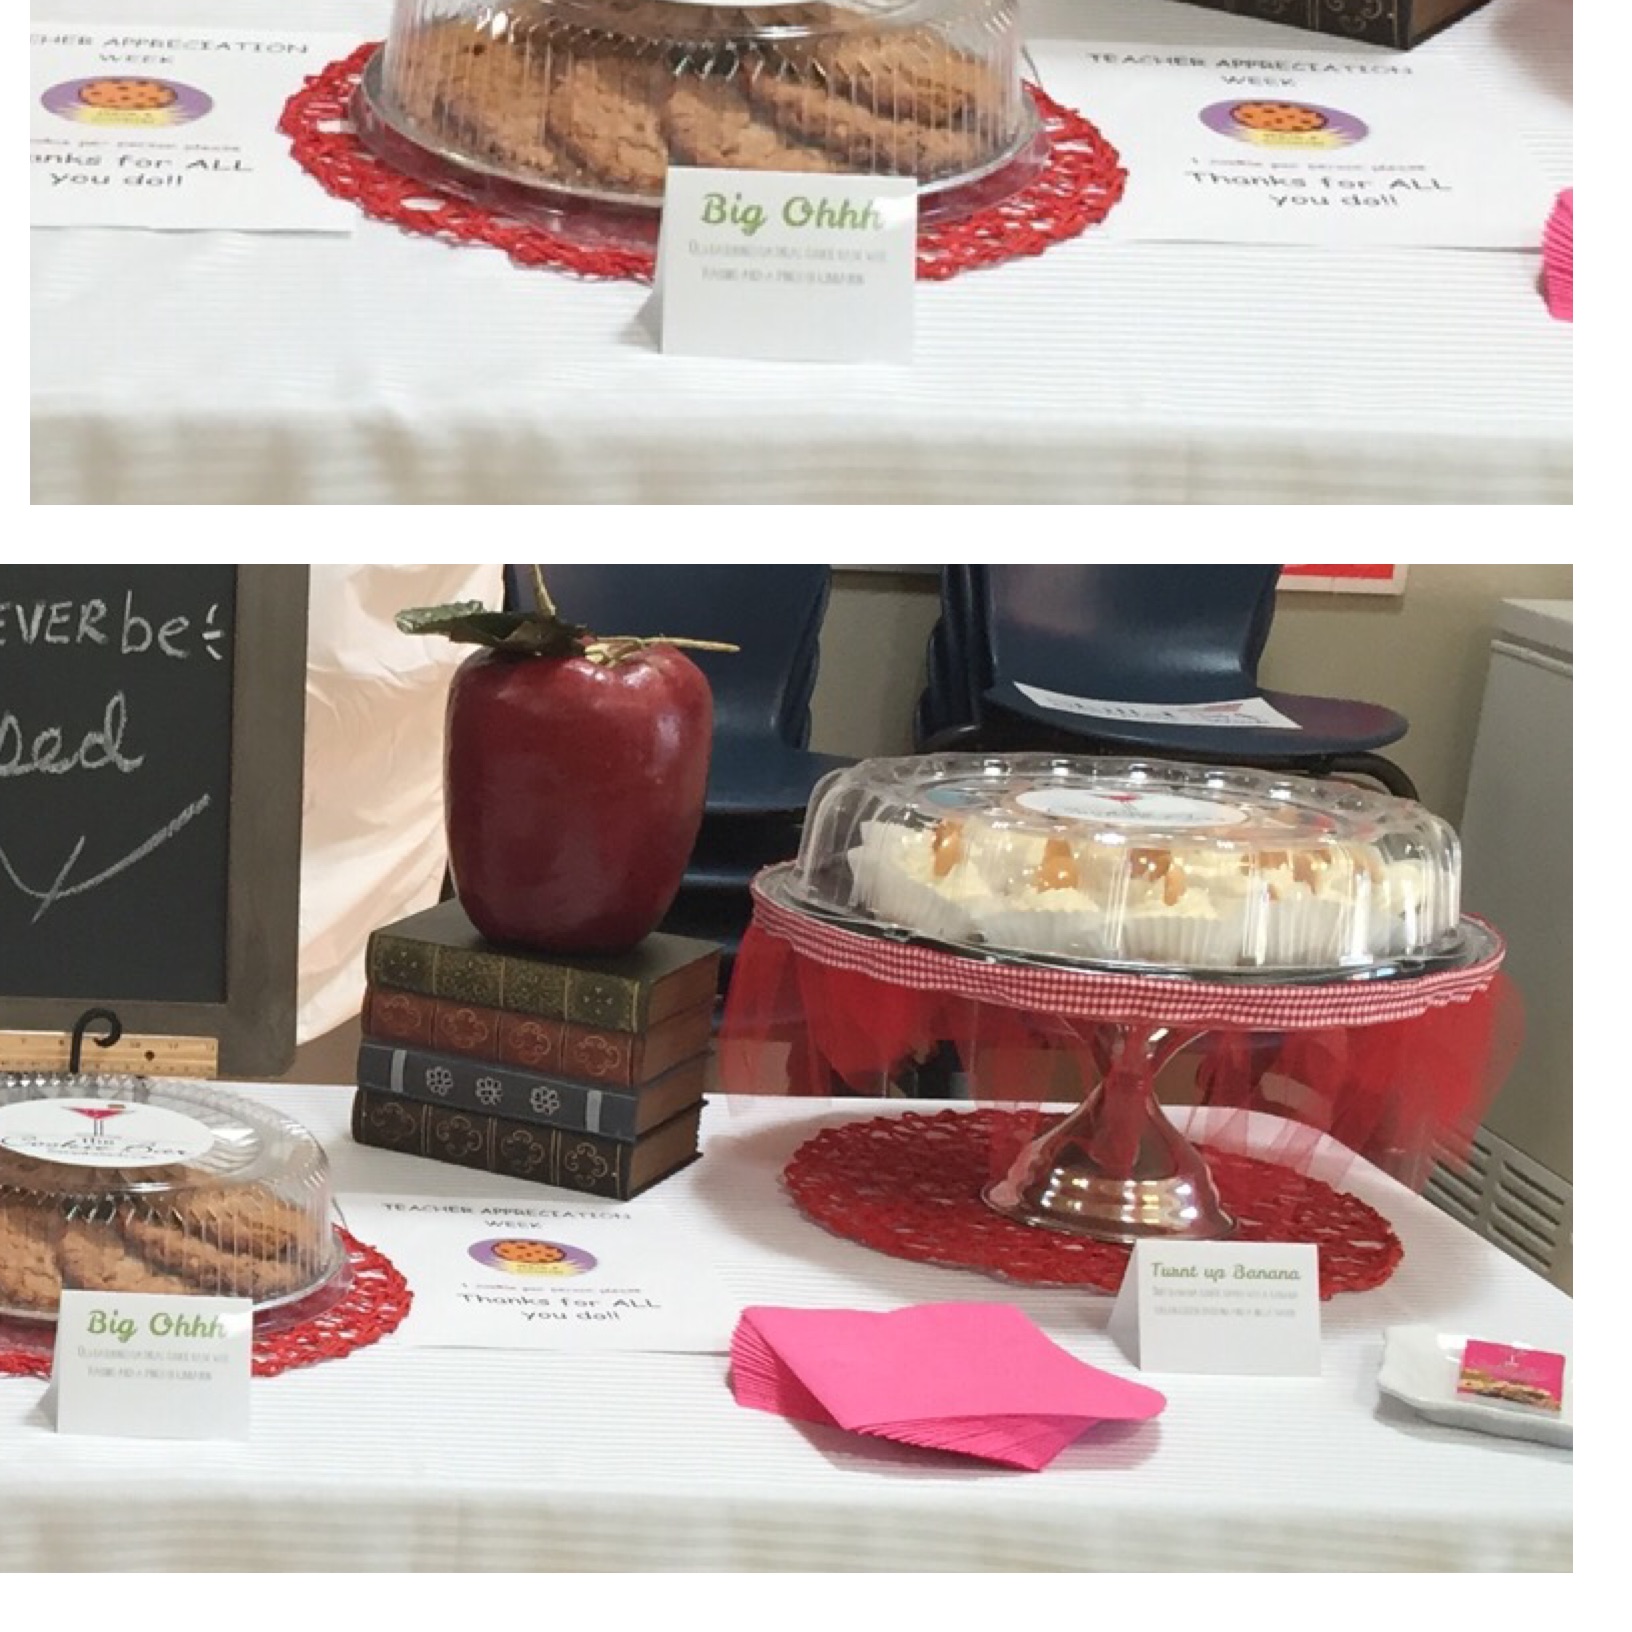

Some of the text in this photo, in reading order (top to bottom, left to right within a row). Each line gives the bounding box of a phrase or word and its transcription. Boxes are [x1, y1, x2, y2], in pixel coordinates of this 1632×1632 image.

[103, 35, 309, 54] APPRECIATION
[99, 55, 174, 64] WEEK
[119, 154, 172, 169] for
[185, 158, 255, 173] ALL
[50, 172, 110, 187] you
[701, 192, 885, 236] Big Ohhh
[122, 589, 191, 658] be
[1151, 1262, 1301, 1283] Turnt up Banana
[86, 1309, 226, 1343] Big Ohhh
